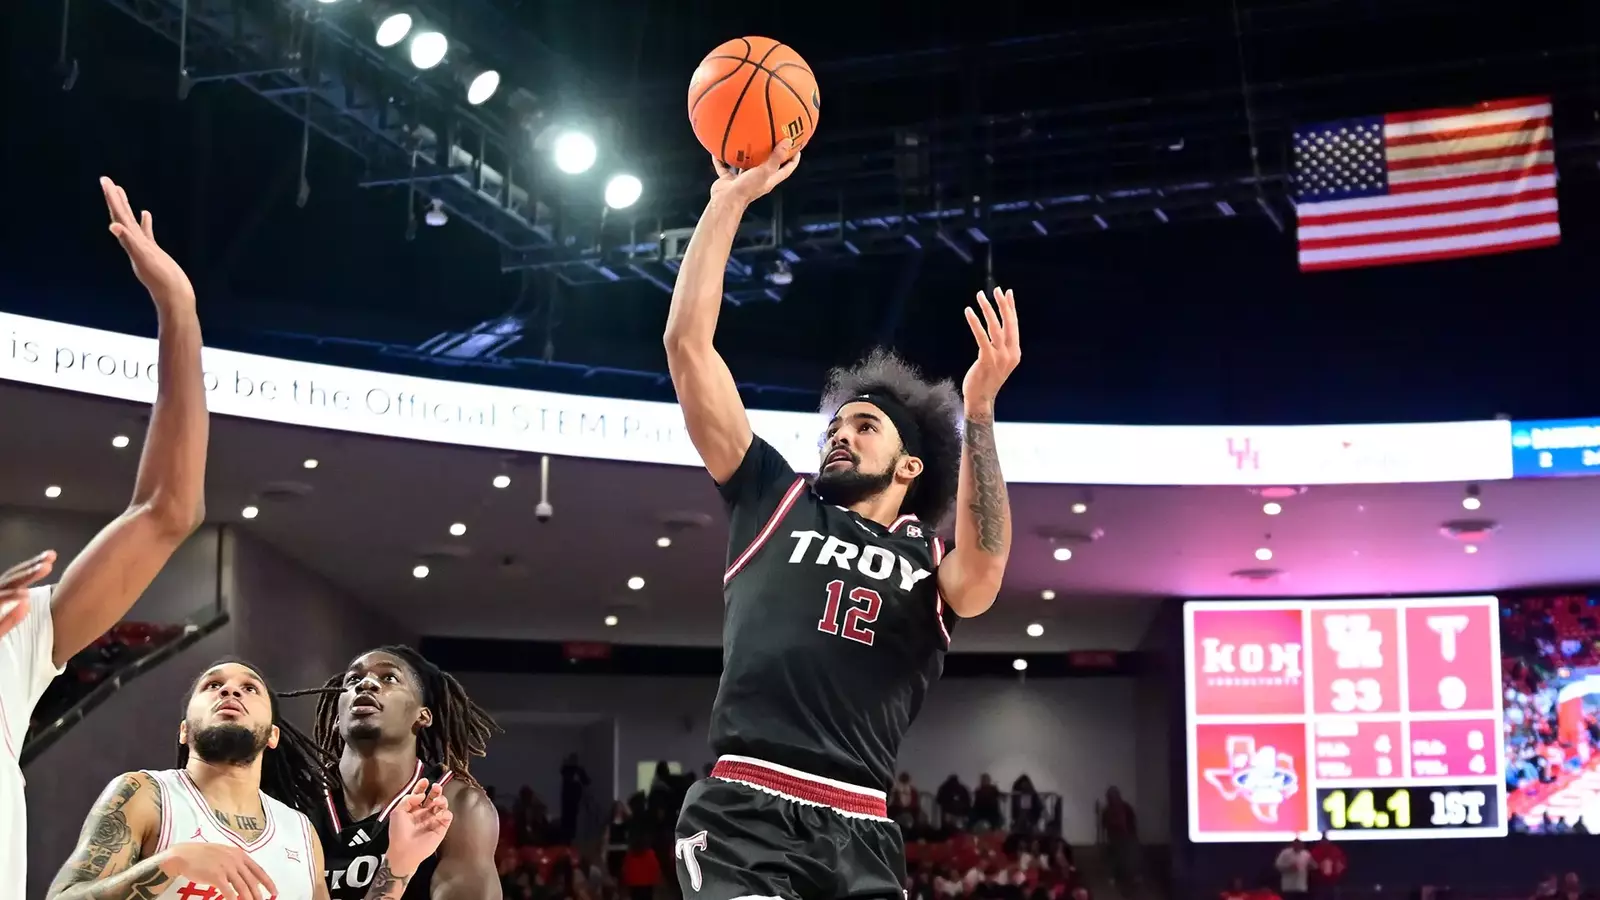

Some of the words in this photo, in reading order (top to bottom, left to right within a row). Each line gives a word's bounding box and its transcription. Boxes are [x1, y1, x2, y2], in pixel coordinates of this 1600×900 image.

[11, 331, 39, 363] is
[203, 371, 218, 391] o
[235, 370, 277, 401] be
[293, 380, 349, 411] the
[366, 388, 496, 426] Official
[512, 405, 606, 438] STEM
[788, 530, 931, 592] TROY
[818, 579, 882, 646] 12
[1331, 678, 1382, 712] 33
[233, 814, 263, 831] THE
[1323, 790, 1410, 828] 14.1
[675, 830, 708, 892] T
